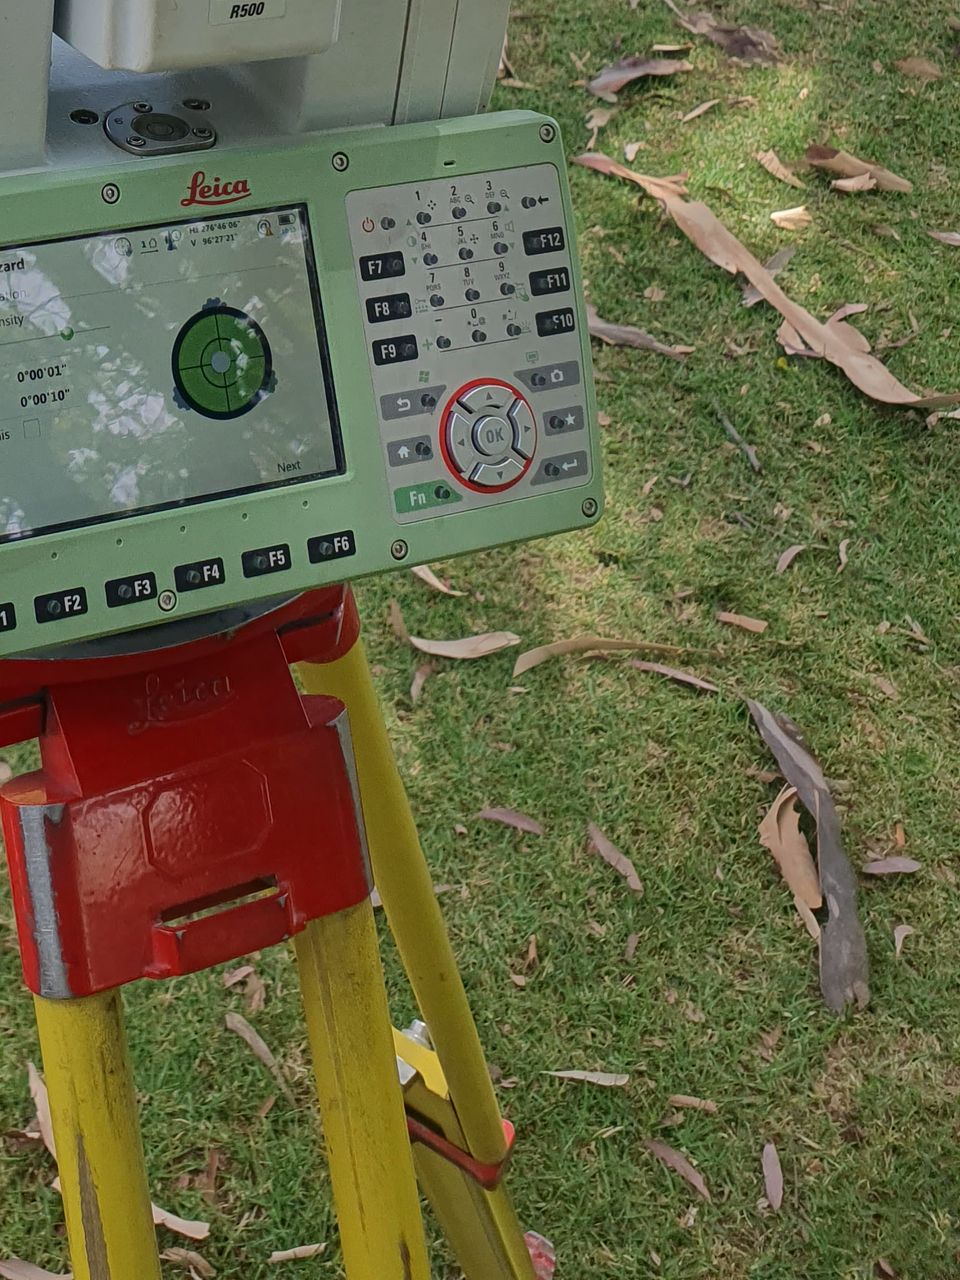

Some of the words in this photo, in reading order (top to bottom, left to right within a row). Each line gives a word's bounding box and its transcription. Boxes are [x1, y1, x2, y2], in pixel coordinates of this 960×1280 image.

[230, 2, 265, 19] R500
[180, 171, 252, 207] Leica
[451, 186, 457, 196] 2
[486, 181, 492, 190] 3
[415, 191, 420, 200] 1
[458, 226, 464, 236] 5
[493, 221, 499, 231] 6
[421, 232, 427, 241] 4
[540, 233, 562, 248] F12
[368, 260, 382, 275] F7
[464, 267, 470, 277] 8
[498, 261, 505, 272] 9
[429, 273, 435, 283] 7
[547, 273, 567, 288] F11
[374, 302, 390, 317] F8
[471, 308, 477, 318] 0
[381, 344, 396, 359] F9
[486, 428, 504, 444] OK
[277, 461, 301, 473] Next
[409, 490, 426, 506] Fn
[334, 535, 350, 553] F6
[269, 550, 286, 567] F5
[203, 564, 220, 582] F4
[134, 579, 151, 598] F3
[64, 594, 82, 613] F2
